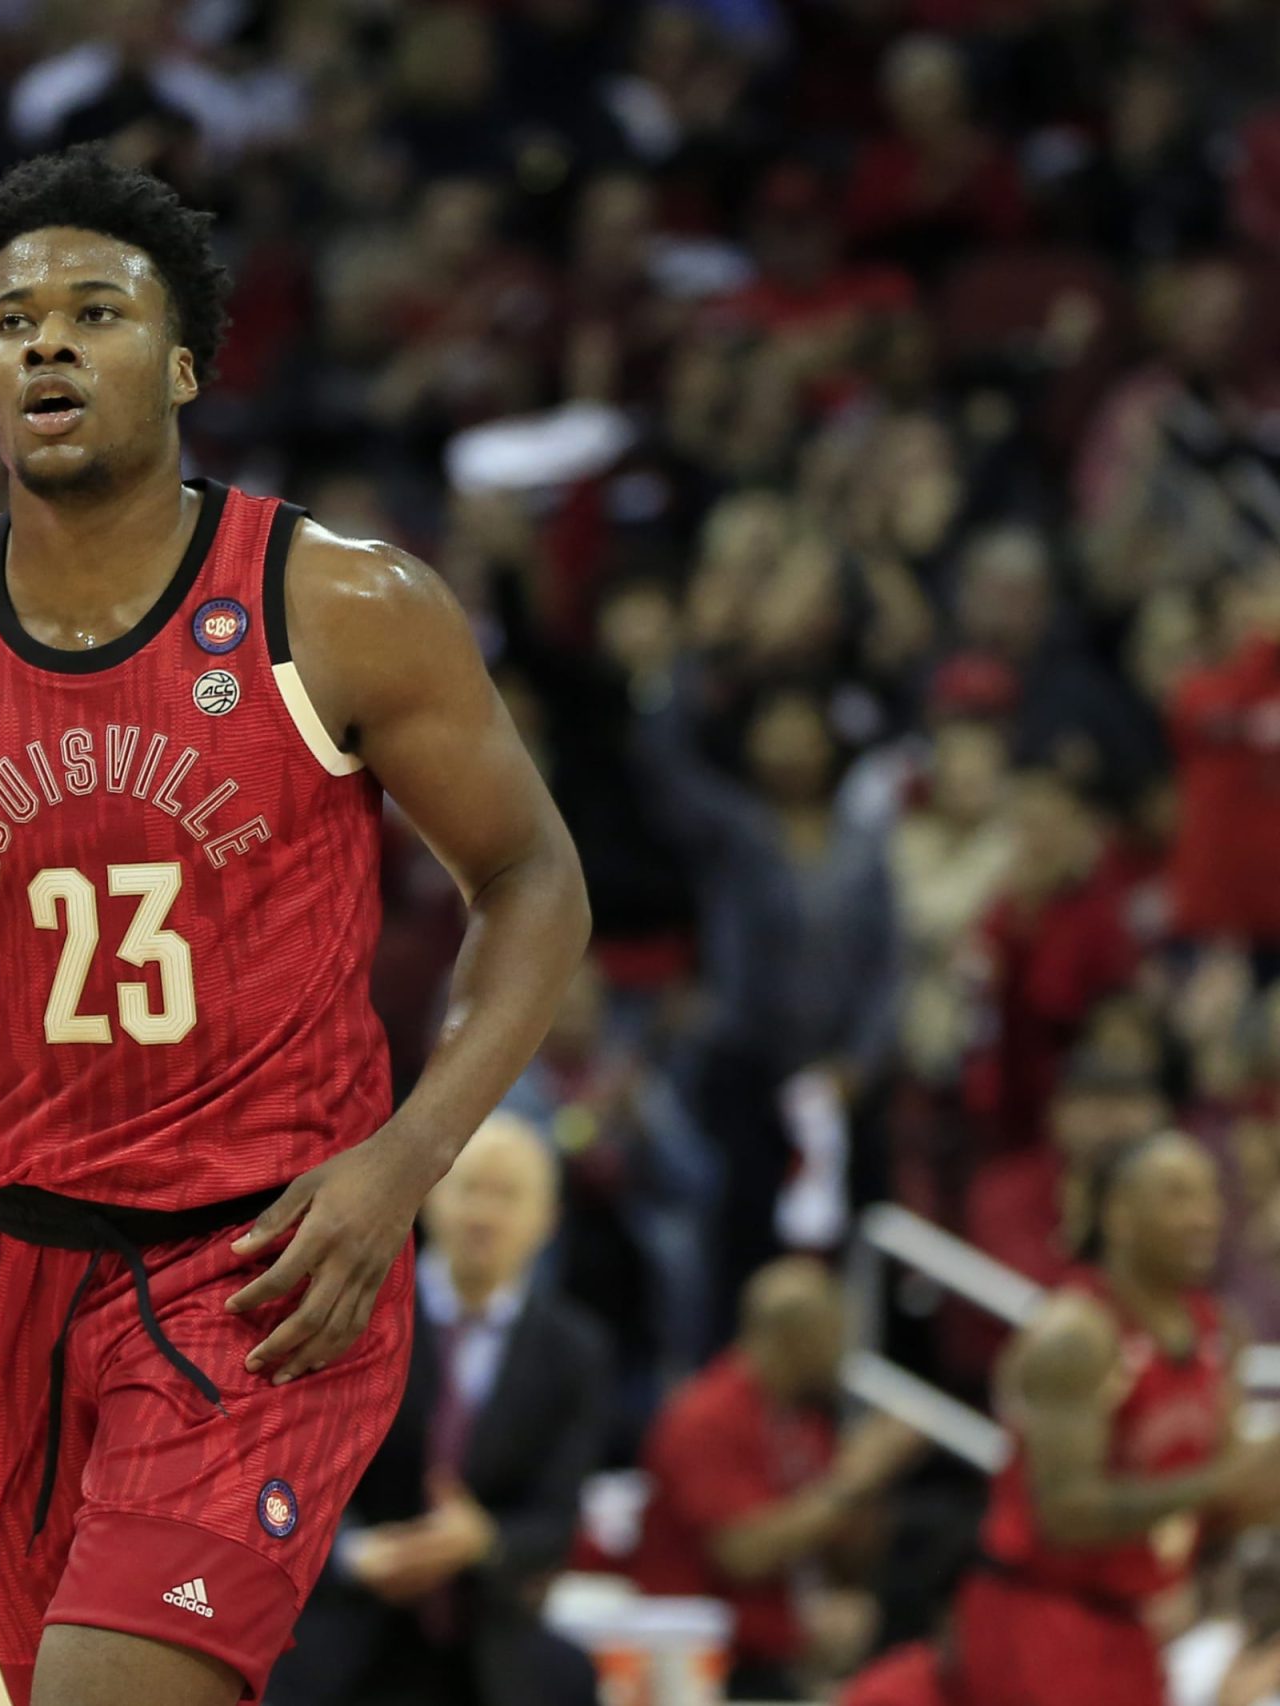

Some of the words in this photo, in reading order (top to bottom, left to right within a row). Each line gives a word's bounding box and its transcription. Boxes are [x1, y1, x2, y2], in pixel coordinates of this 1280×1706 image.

[201, 684, 234, 696] ACC
[27, 862, 197, 1046] 23
[162, 1592, 214, 1618] adidas
